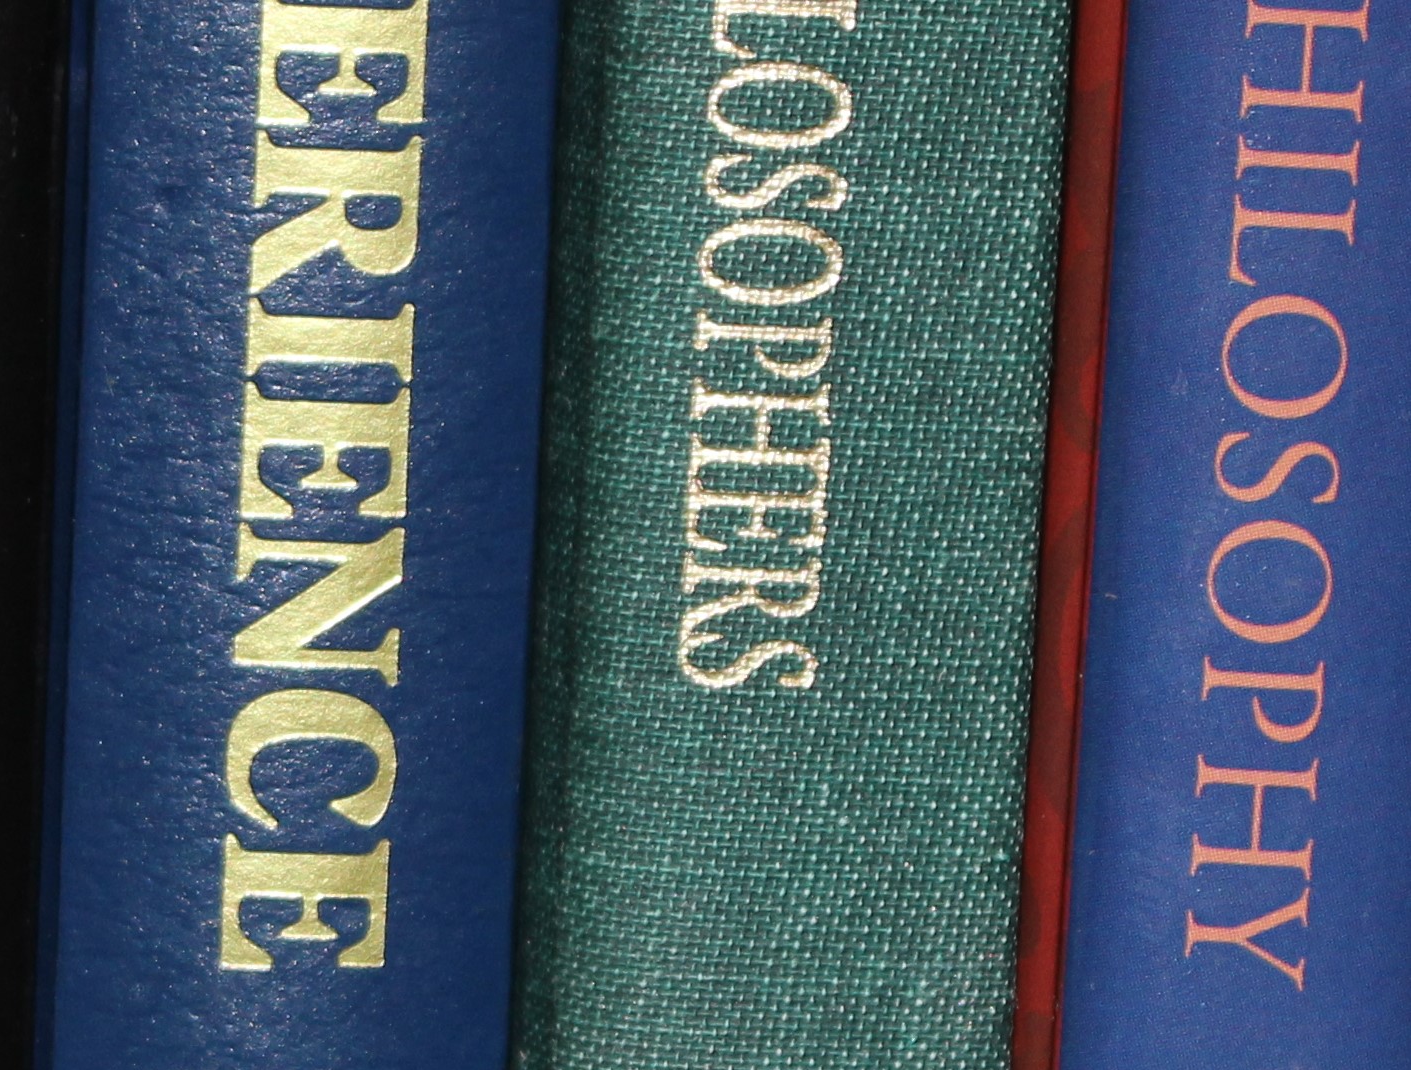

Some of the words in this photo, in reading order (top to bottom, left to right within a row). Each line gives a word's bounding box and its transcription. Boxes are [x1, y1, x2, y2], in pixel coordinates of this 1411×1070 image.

[218, 0, 430, 973] ERIENCE
[679, 0, 858, 688] LOSOPHERS
[1184, 0, 1370, 990] HILOSOPHY
